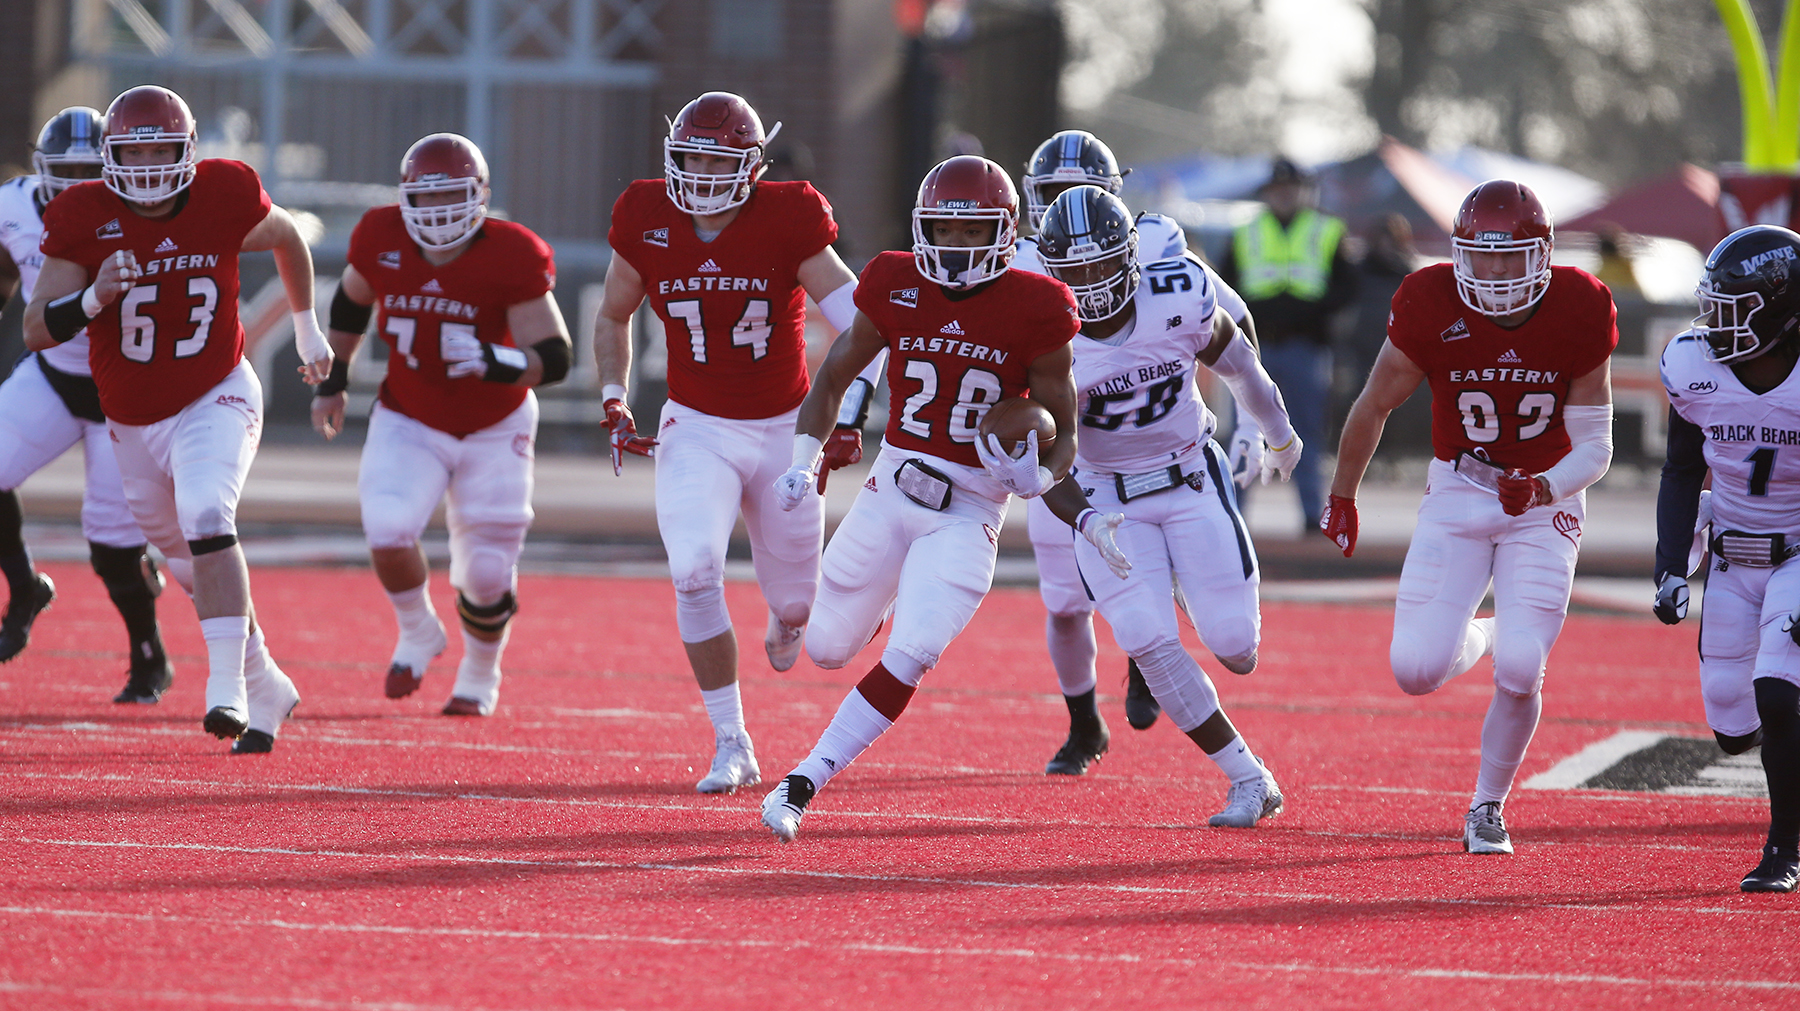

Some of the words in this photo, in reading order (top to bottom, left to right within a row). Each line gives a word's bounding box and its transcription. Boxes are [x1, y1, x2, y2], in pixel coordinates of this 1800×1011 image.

[690, 136, 715, 144] Riddell
[653, 230, 667, 239] SKY
[136, 254, 219, 277] ASTERN
[1740, 245, 1798, 276] MAINE
[658, 277, 768, 294] EASTERN
[901, 290, 917, 299] SKY
[384, 294, 479, 319] EASTERN
[119, 276, 220, 363] 63
[1451, 321, 1465, 333] SKY
[665, 298, 777, 365] 74
[940, 327, 965, 336] adidas
[898, 336, 1009, 365] EASTERN
[1087, 372, 1135, 398] BLACK
[1137, 359, 1183, 383] BEARS
[1450, 368, 1559, 384] EASTERN
[1688, 380, 1714, 391] CAA
[898, 357, 1004, 445] 28
[1710, 424, 1757, 442] BLACK
[1742, 445, 1780, 498] 1
